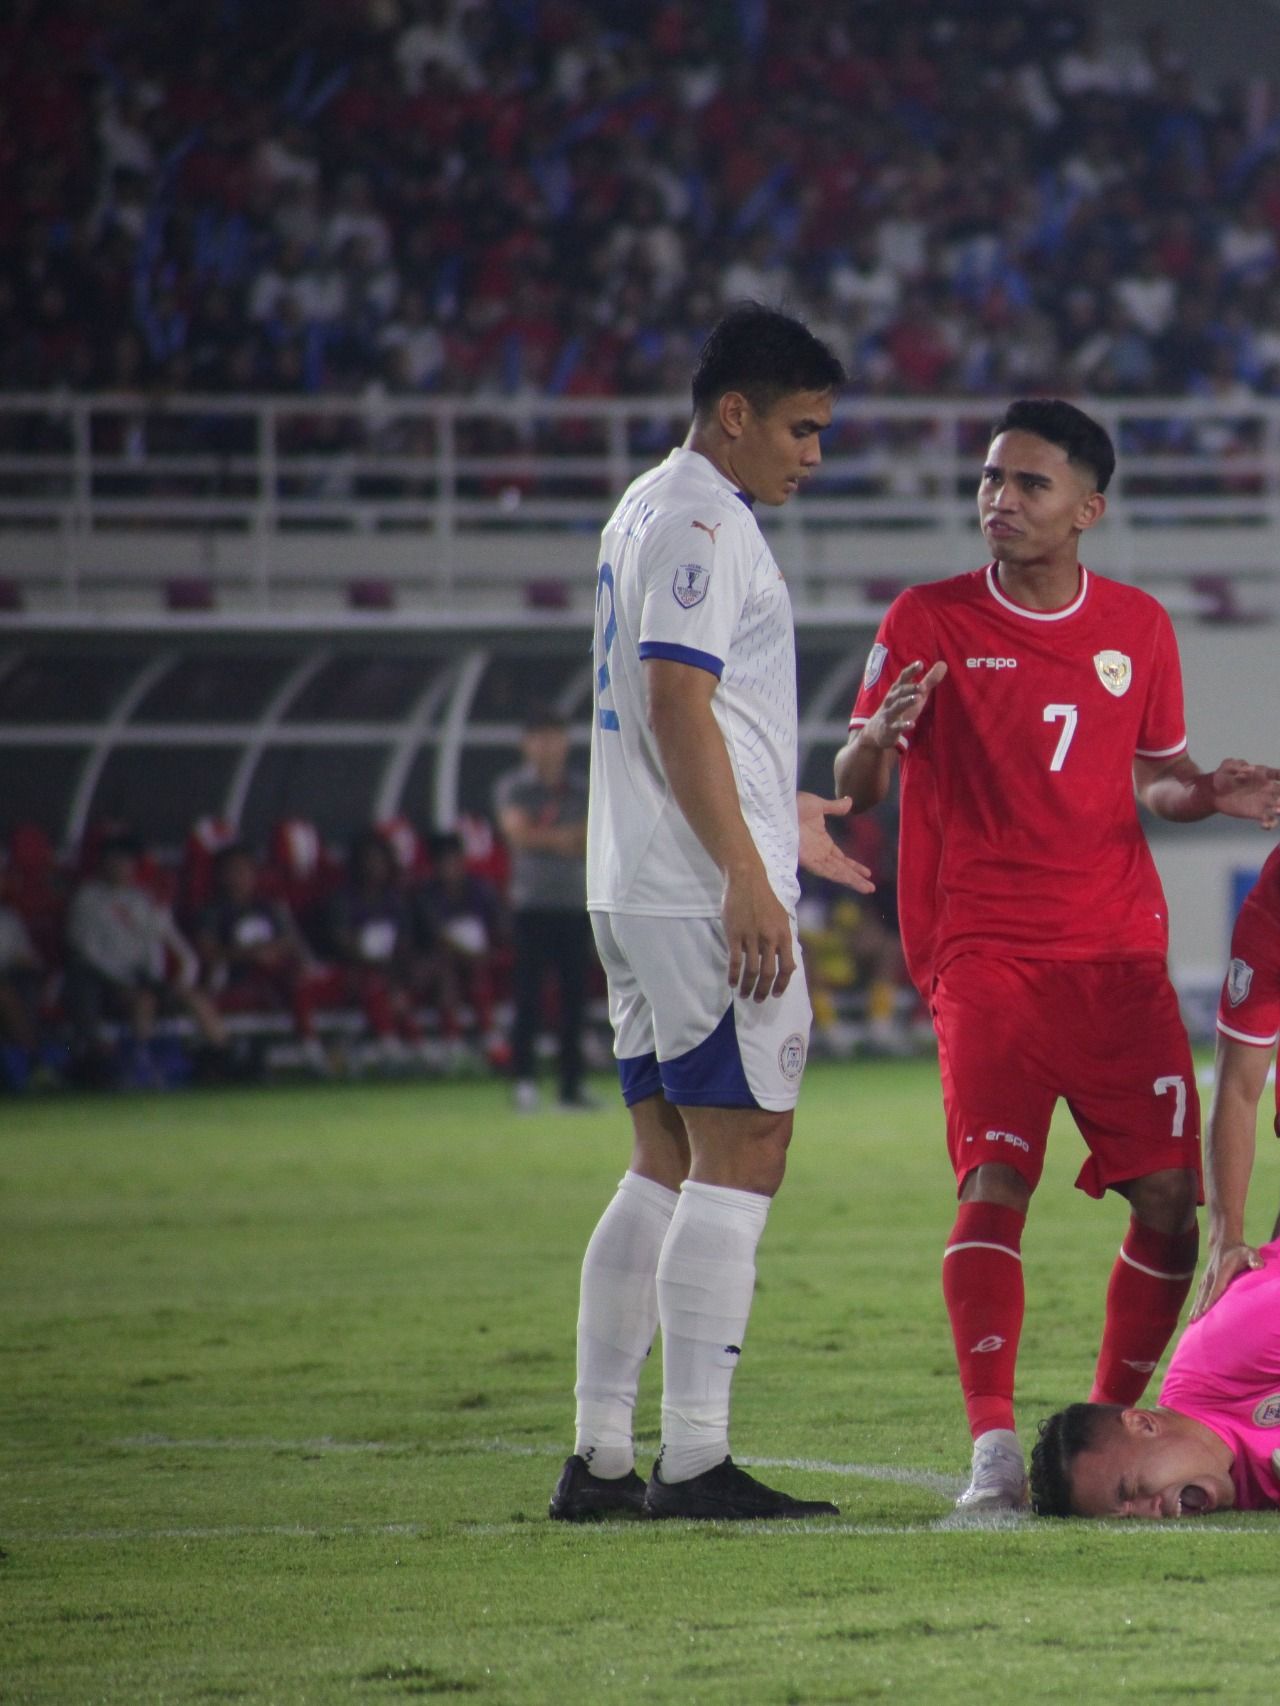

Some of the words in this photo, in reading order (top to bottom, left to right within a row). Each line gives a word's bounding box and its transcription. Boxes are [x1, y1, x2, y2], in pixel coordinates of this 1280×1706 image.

[966, 657, 1017, 669] erspo
[1043, 704, 1078, 771] 7
[1153, 1075, 1187, 1137] 7
[985, 1129, 1029, 1153] erspo
